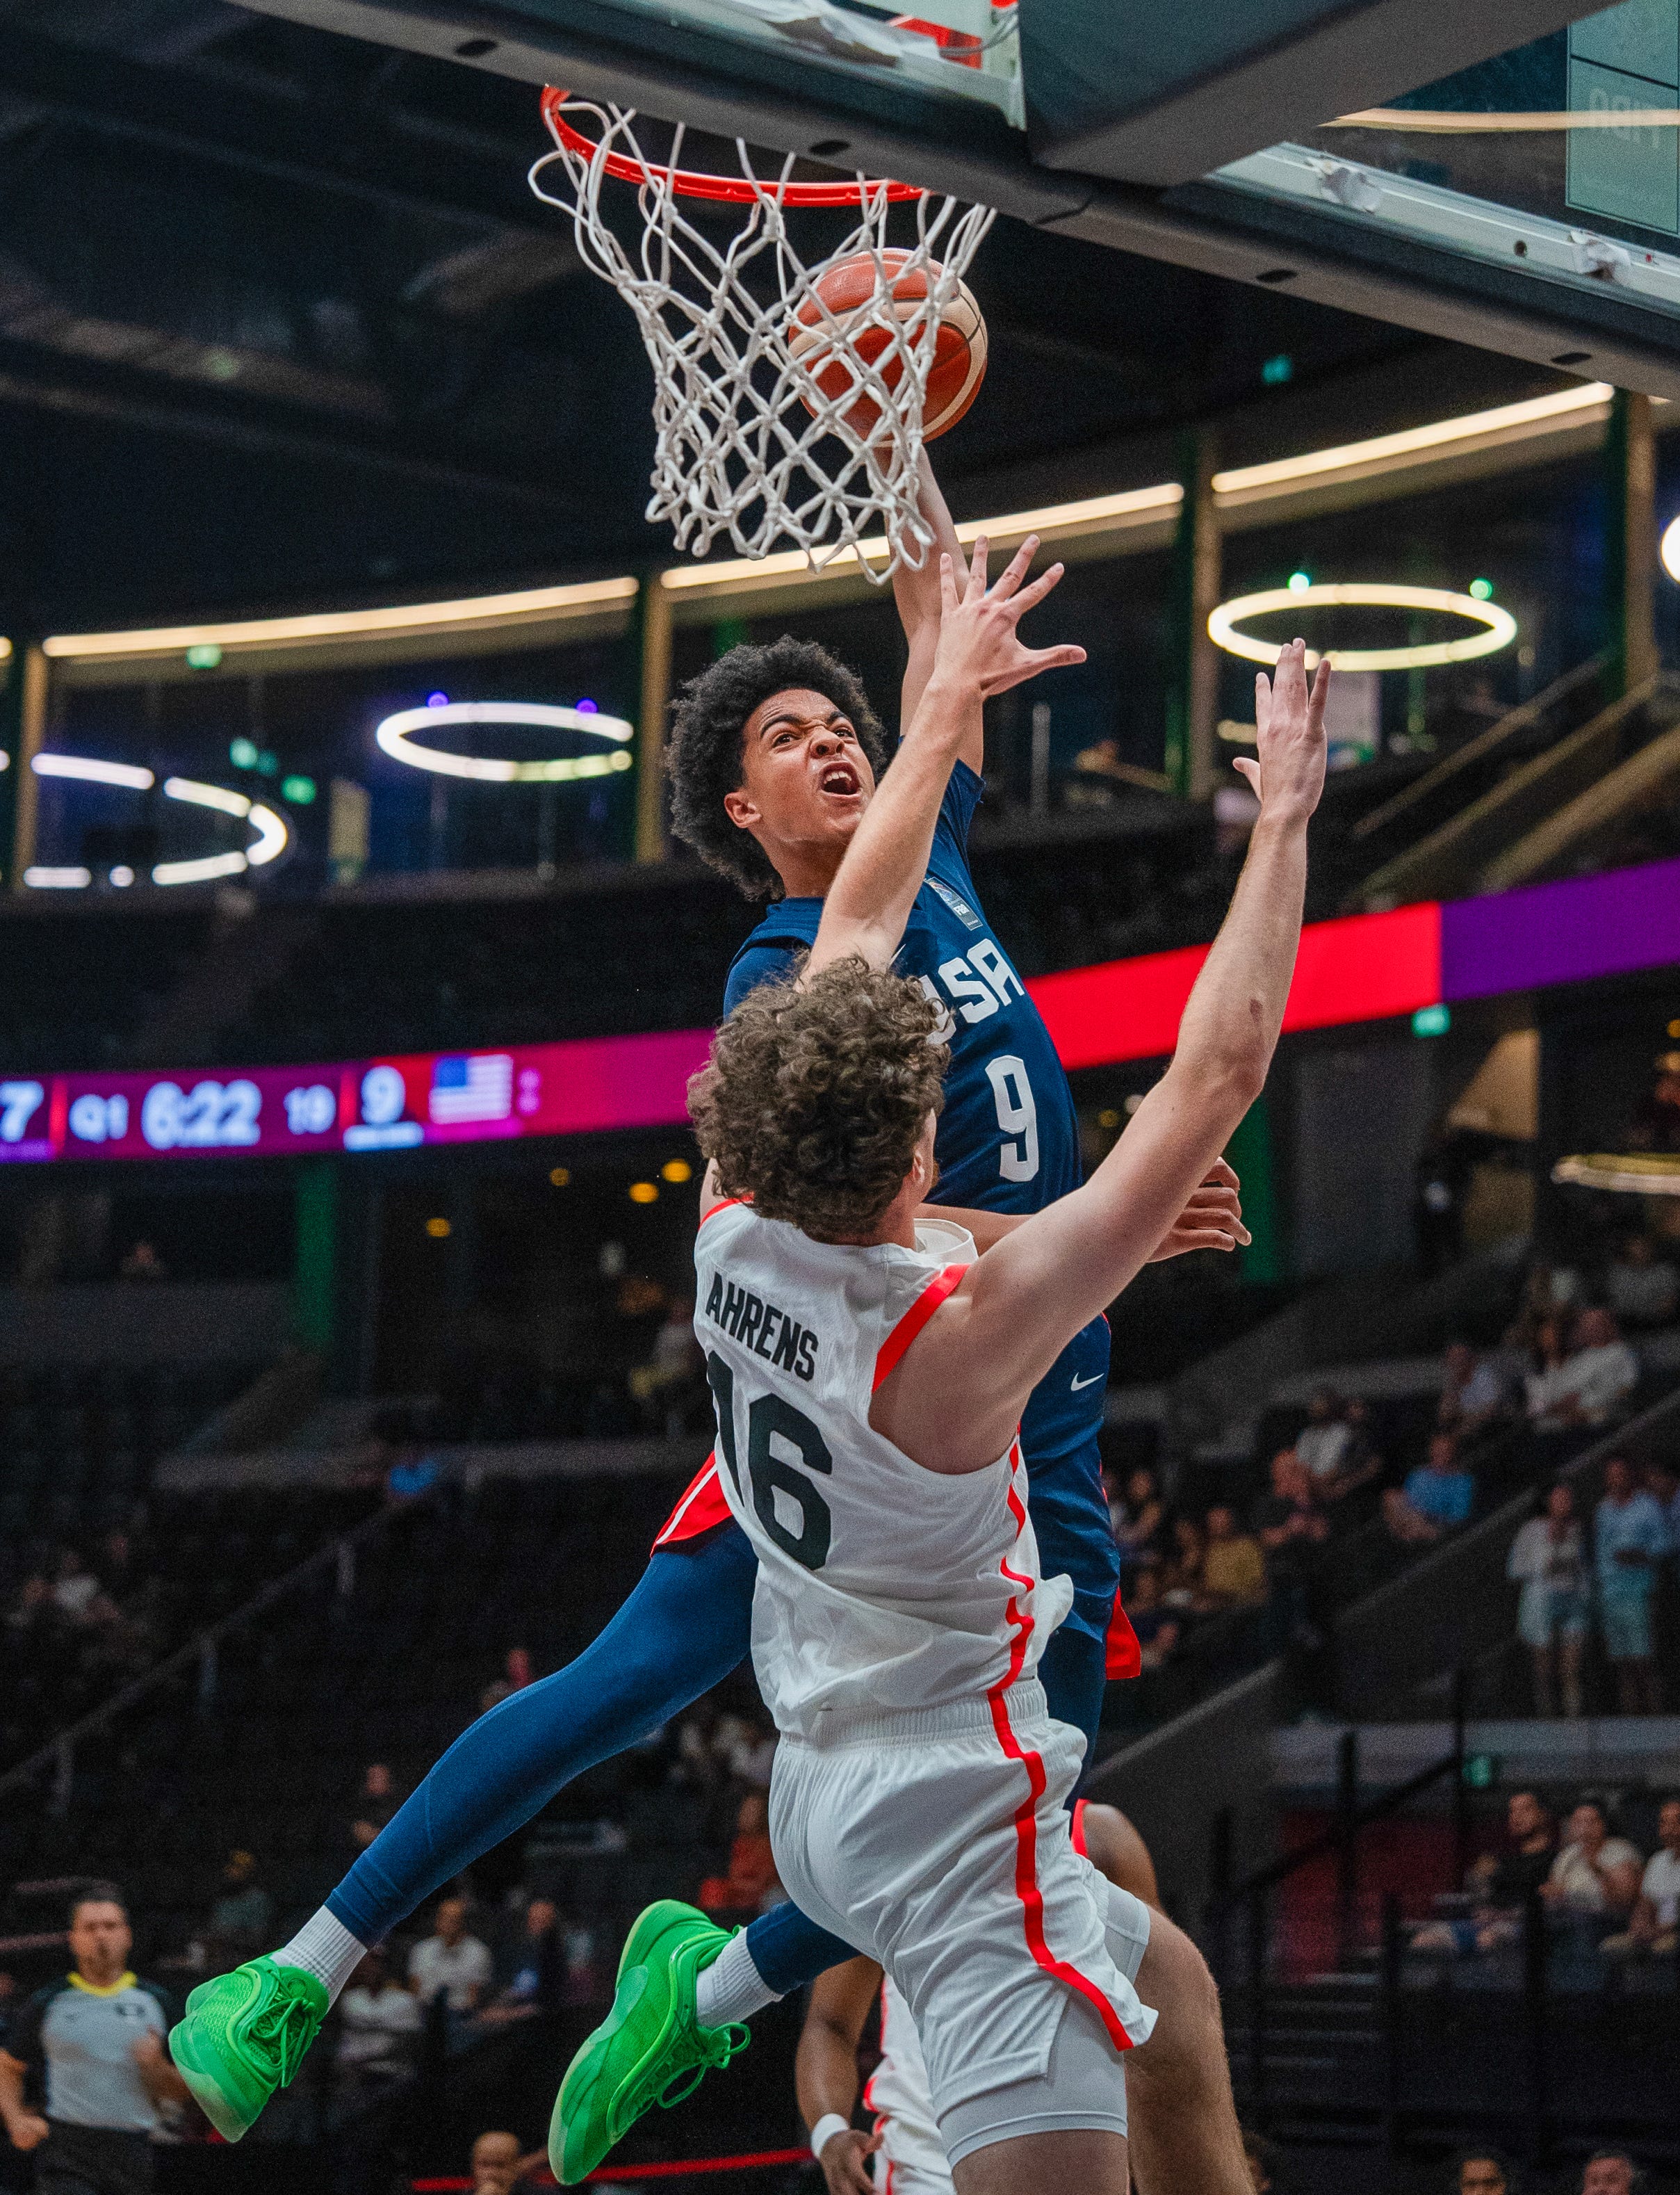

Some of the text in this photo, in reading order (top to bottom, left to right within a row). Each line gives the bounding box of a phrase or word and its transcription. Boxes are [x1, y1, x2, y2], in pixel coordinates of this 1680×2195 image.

[0, 1080, 44, 1143] 7
[361, 1065, 406, 1124] 9
[985, 1055, 1039, 1182] 9
[706, 1272, 818, 1382] AHRENS
[707, 1350, 833, 1571] 16
